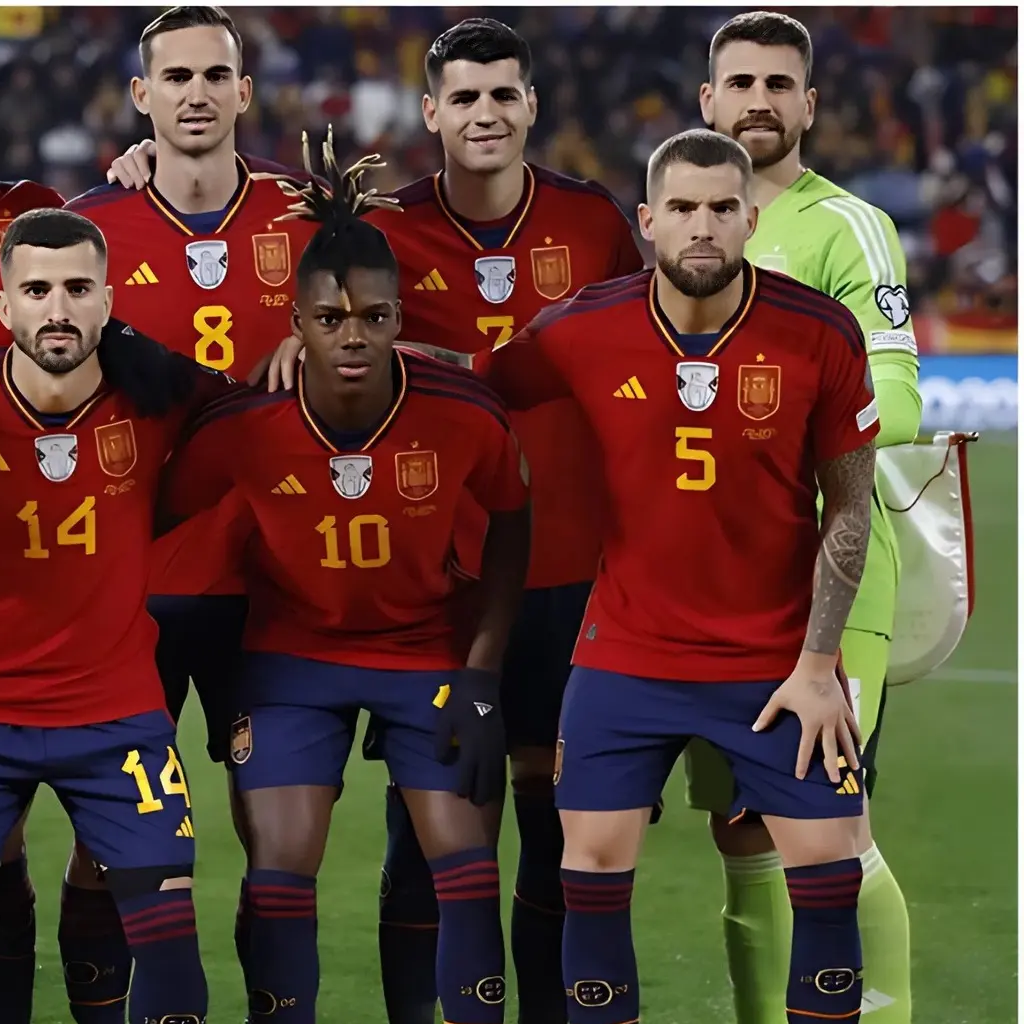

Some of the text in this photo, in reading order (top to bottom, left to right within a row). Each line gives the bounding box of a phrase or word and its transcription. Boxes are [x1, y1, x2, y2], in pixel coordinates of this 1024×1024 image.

[192, 305, 235, 371] 8
[476, 315, 515, 352] 7
[674, 427, 717, 491] 5
[17, 495, 96, 558] 14
[315, 514, 391, 569] 10
[121, 745, 191, 814] 14
